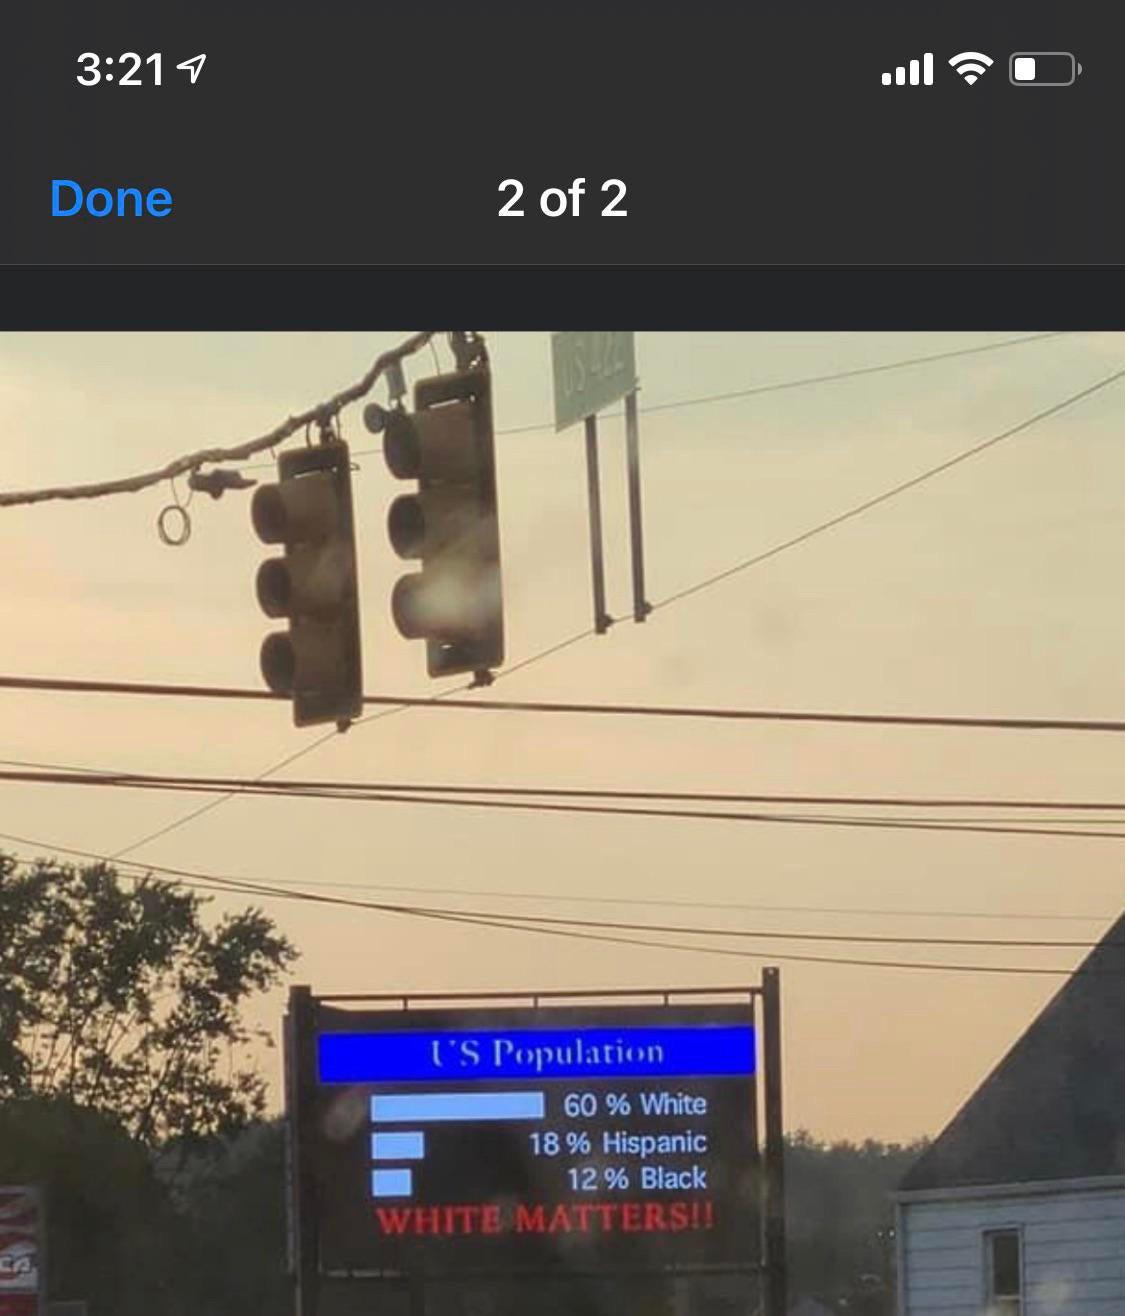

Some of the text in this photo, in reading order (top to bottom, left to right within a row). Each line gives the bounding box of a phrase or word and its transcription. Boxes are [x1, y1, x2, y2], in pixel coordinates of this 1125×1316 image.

[431, 1038, 664, 1073] US Population
[564, 1091, 707, 1117] 60 % White
[530, 1129, 707, 1159] 18 % Hispanic
[568, 1165, 707, 1191] 12 % Black
[376, 1202, 715, 1234] WHITE MATTERS!!
